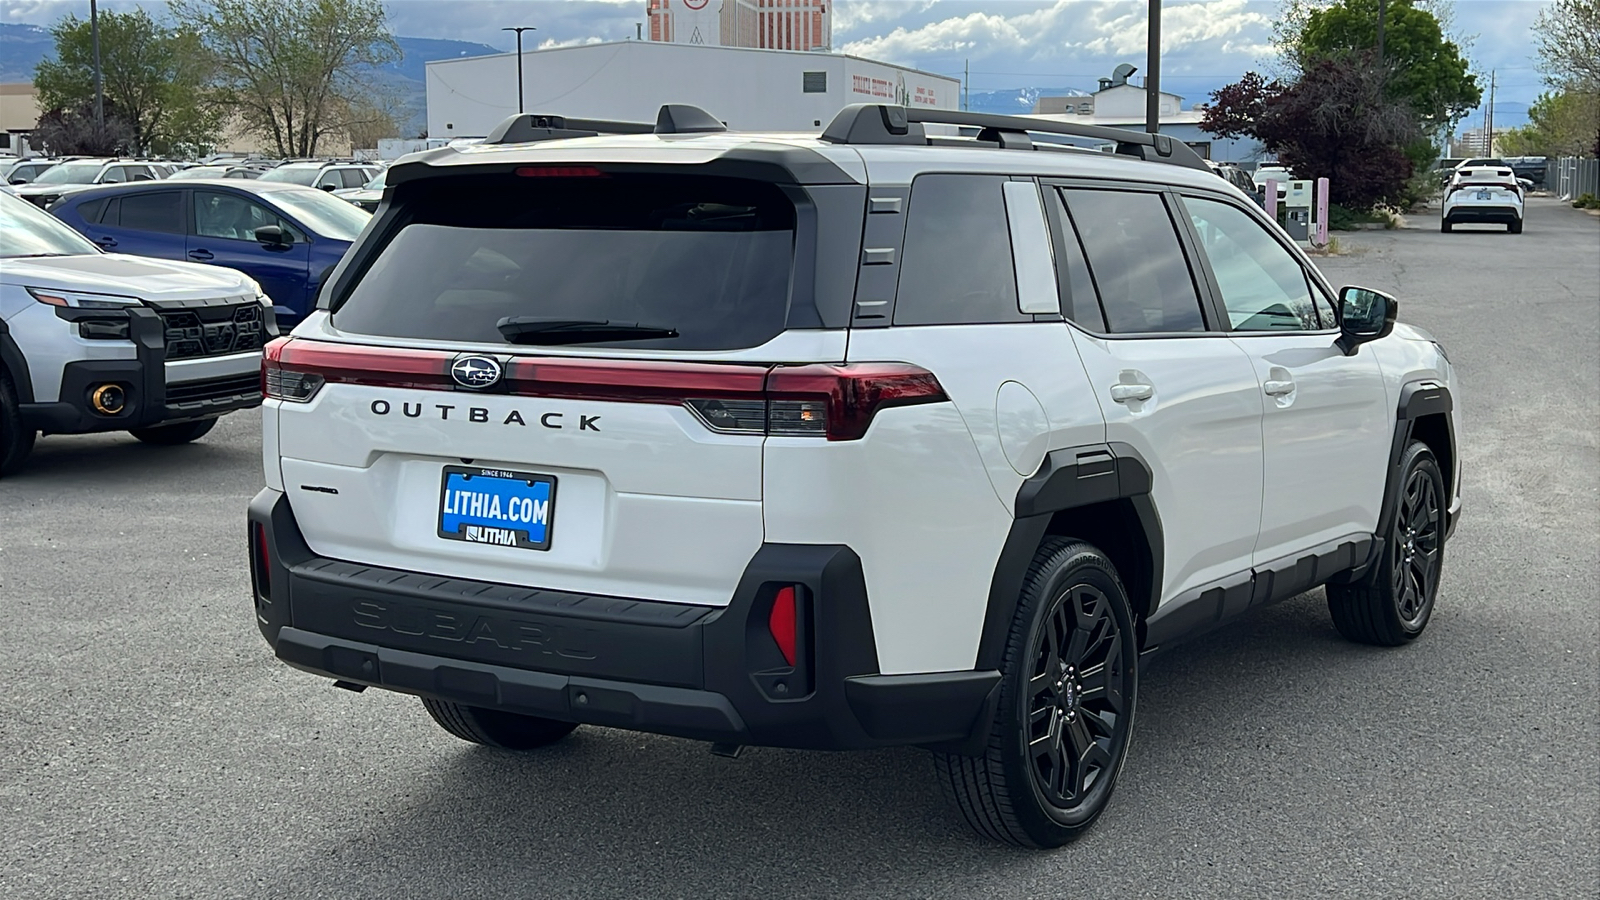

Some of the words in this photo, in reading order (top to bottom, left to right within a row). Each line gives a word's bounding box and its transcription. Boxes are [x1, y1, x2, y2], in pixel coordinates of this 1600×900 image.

[165, 321, 262, 340] SUBARU
[370, 399, 602, 432] OUTBACK
[481, 469, 499, 478] SINCE
[443, 489, 549, 526] LITHIA.COM
[477, 526, 517, 546] LITHIA
[351, 596, 598, 661] SUBARU
